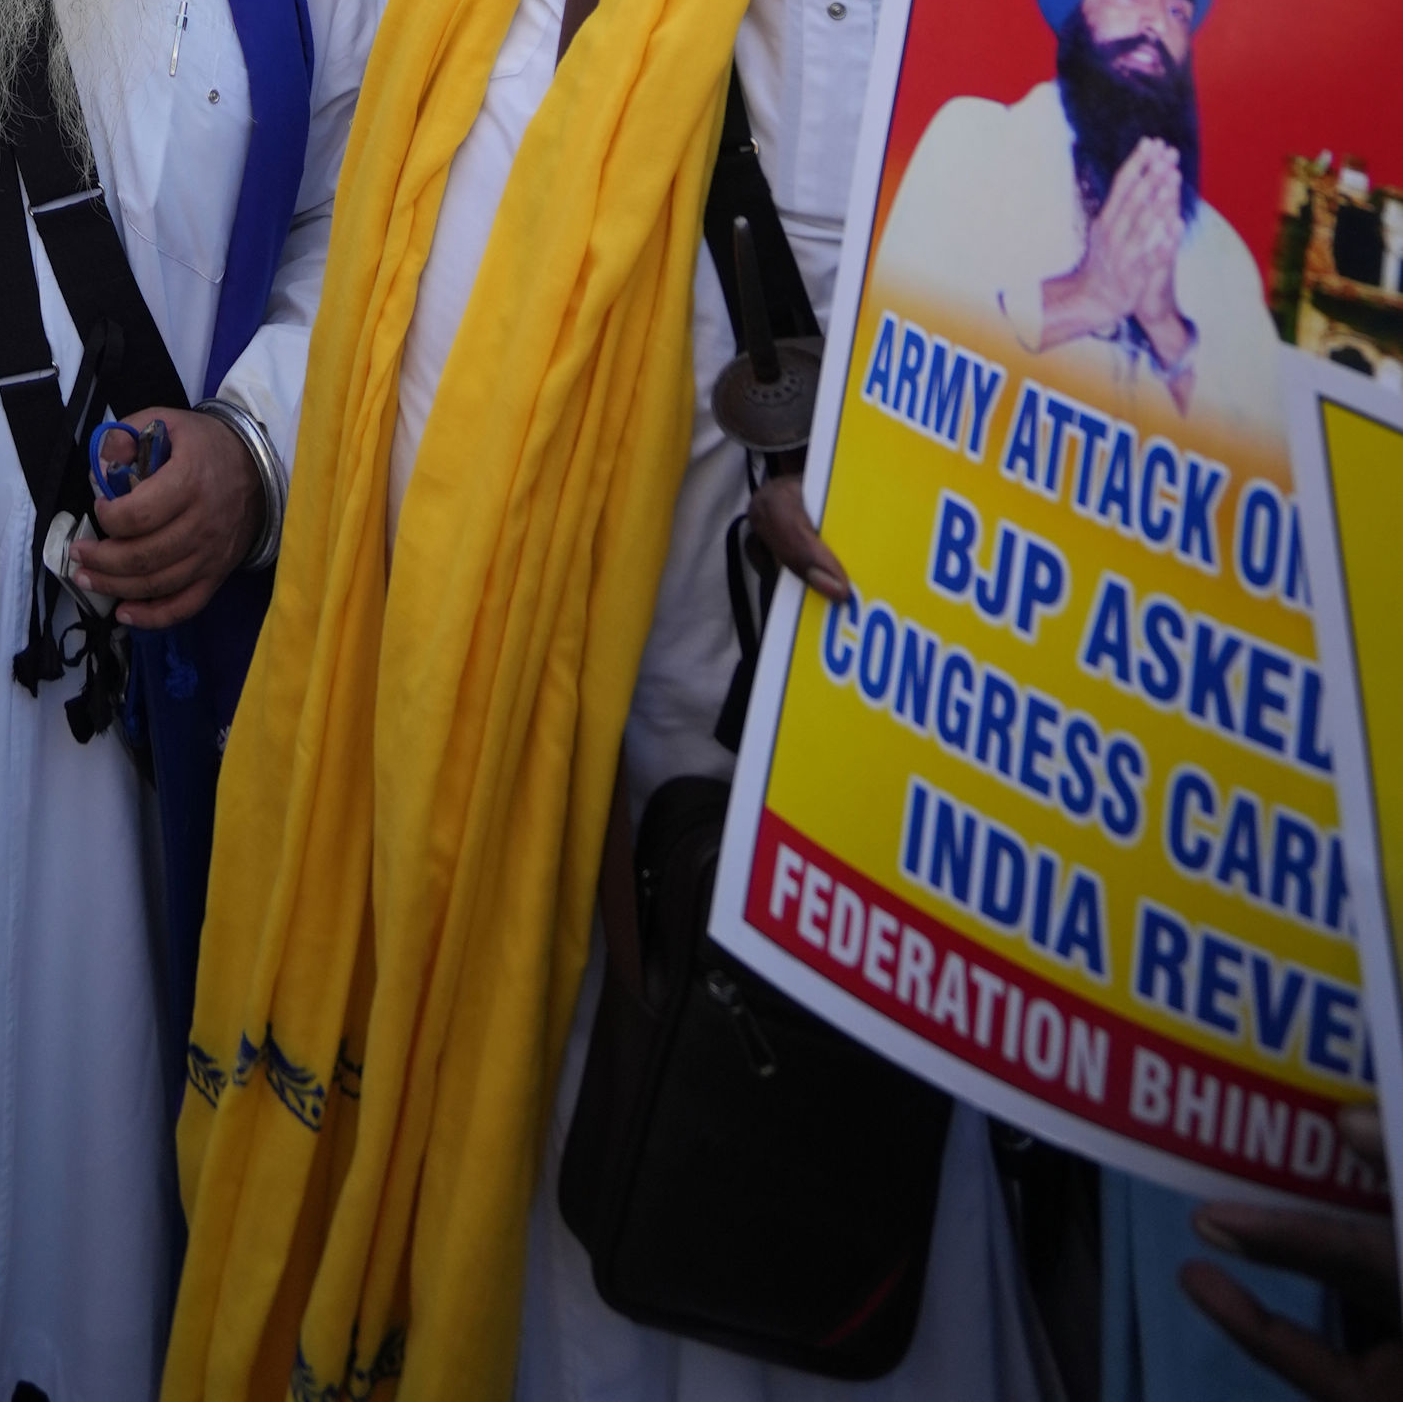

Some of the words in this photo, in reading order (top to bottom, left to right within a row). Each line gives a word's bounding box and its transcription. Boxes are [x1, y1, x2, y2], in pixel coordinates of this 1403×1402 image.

[862, 316, 1003, 457] ARMY
[1004, 387, 1224, 567] ATTACK
[932, 497, 1066, 635] BJP
[823, 593, 1144, 838] CONGRESS
[769, 844, 1110, 1101] FEDERATION
[903, 783, 1105, 976] INDIA
[1137, 907, 1377, 1083] REVE
